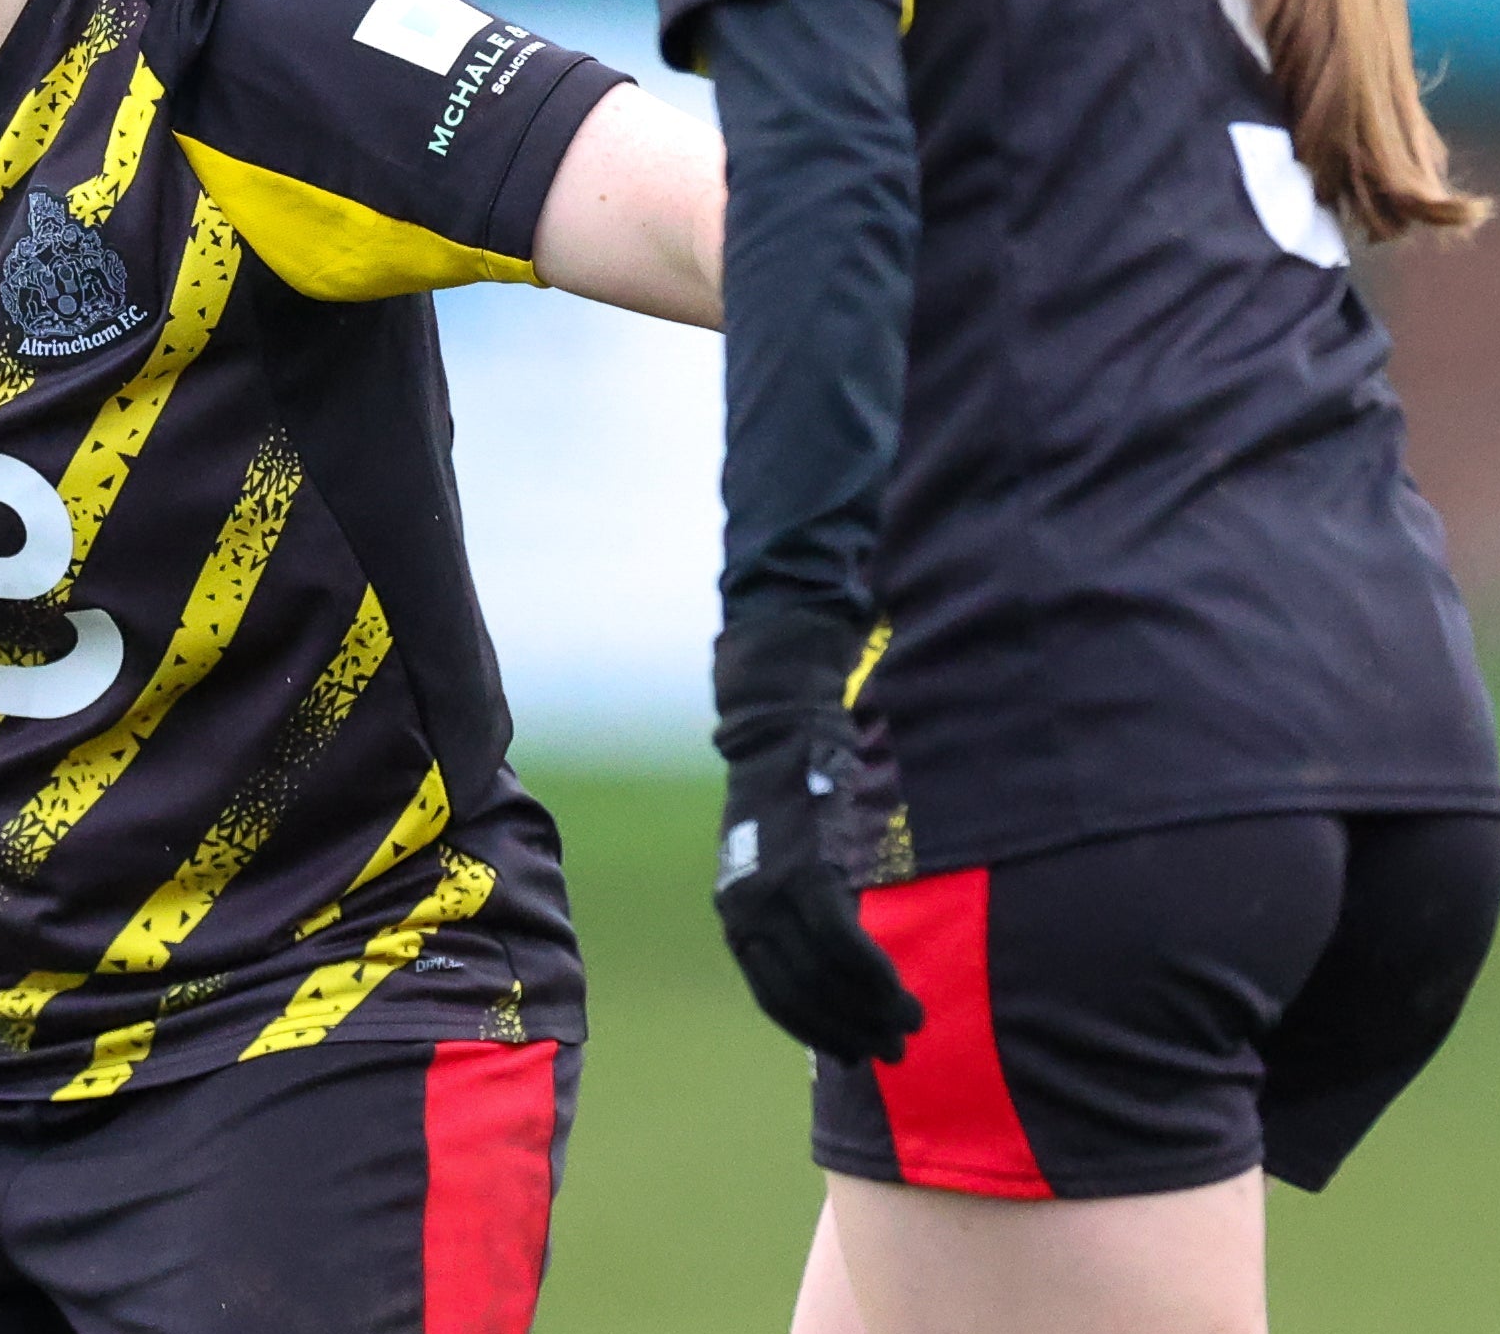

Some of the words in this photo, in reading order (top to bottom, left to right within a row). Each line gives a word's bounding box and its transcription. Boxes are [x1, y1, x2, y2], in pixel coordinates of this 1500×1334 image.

[427, 32, 516, 157] MCHALE
[17, 323, 123, 356] Altrincham
[117, 304, 148, 331] F.C.
